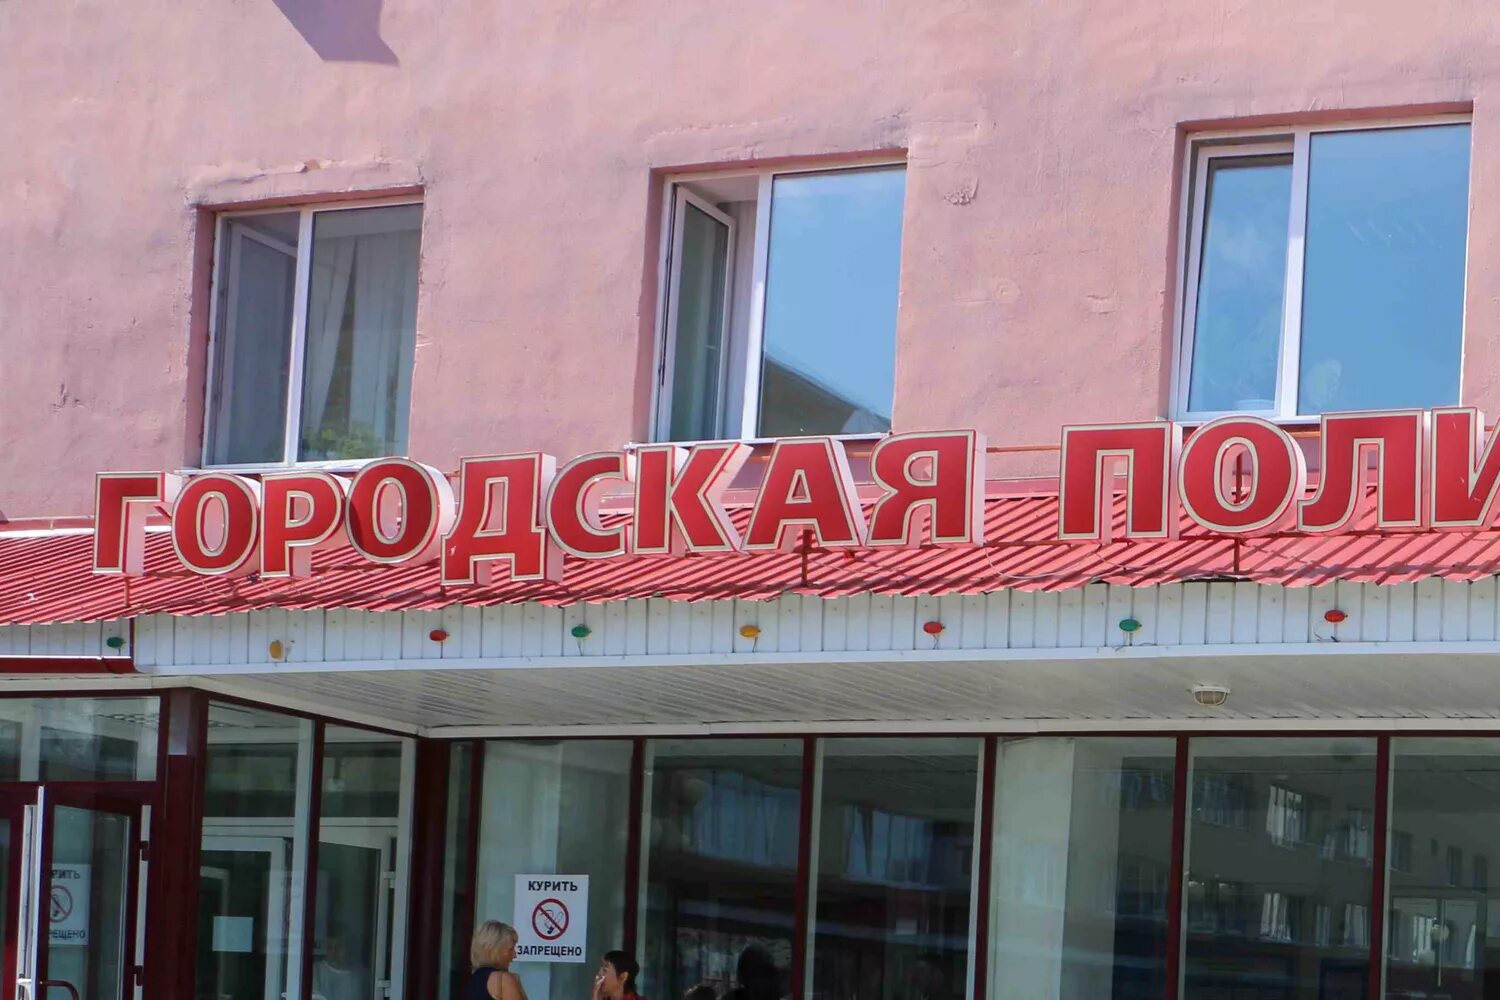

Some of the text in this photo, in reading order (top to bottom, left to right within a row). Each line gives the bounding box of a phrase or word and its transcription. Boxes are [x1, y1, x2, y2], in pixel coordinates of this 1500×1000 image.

[91, 428, 986, 586] ГОРОДСКАЯ
[51, 869, 81, 879] РИТЬ
[528, 881, 578, 892] КУРИТЬ
[517, 945, 582, 957] ЗАПРЕЩЕНО
